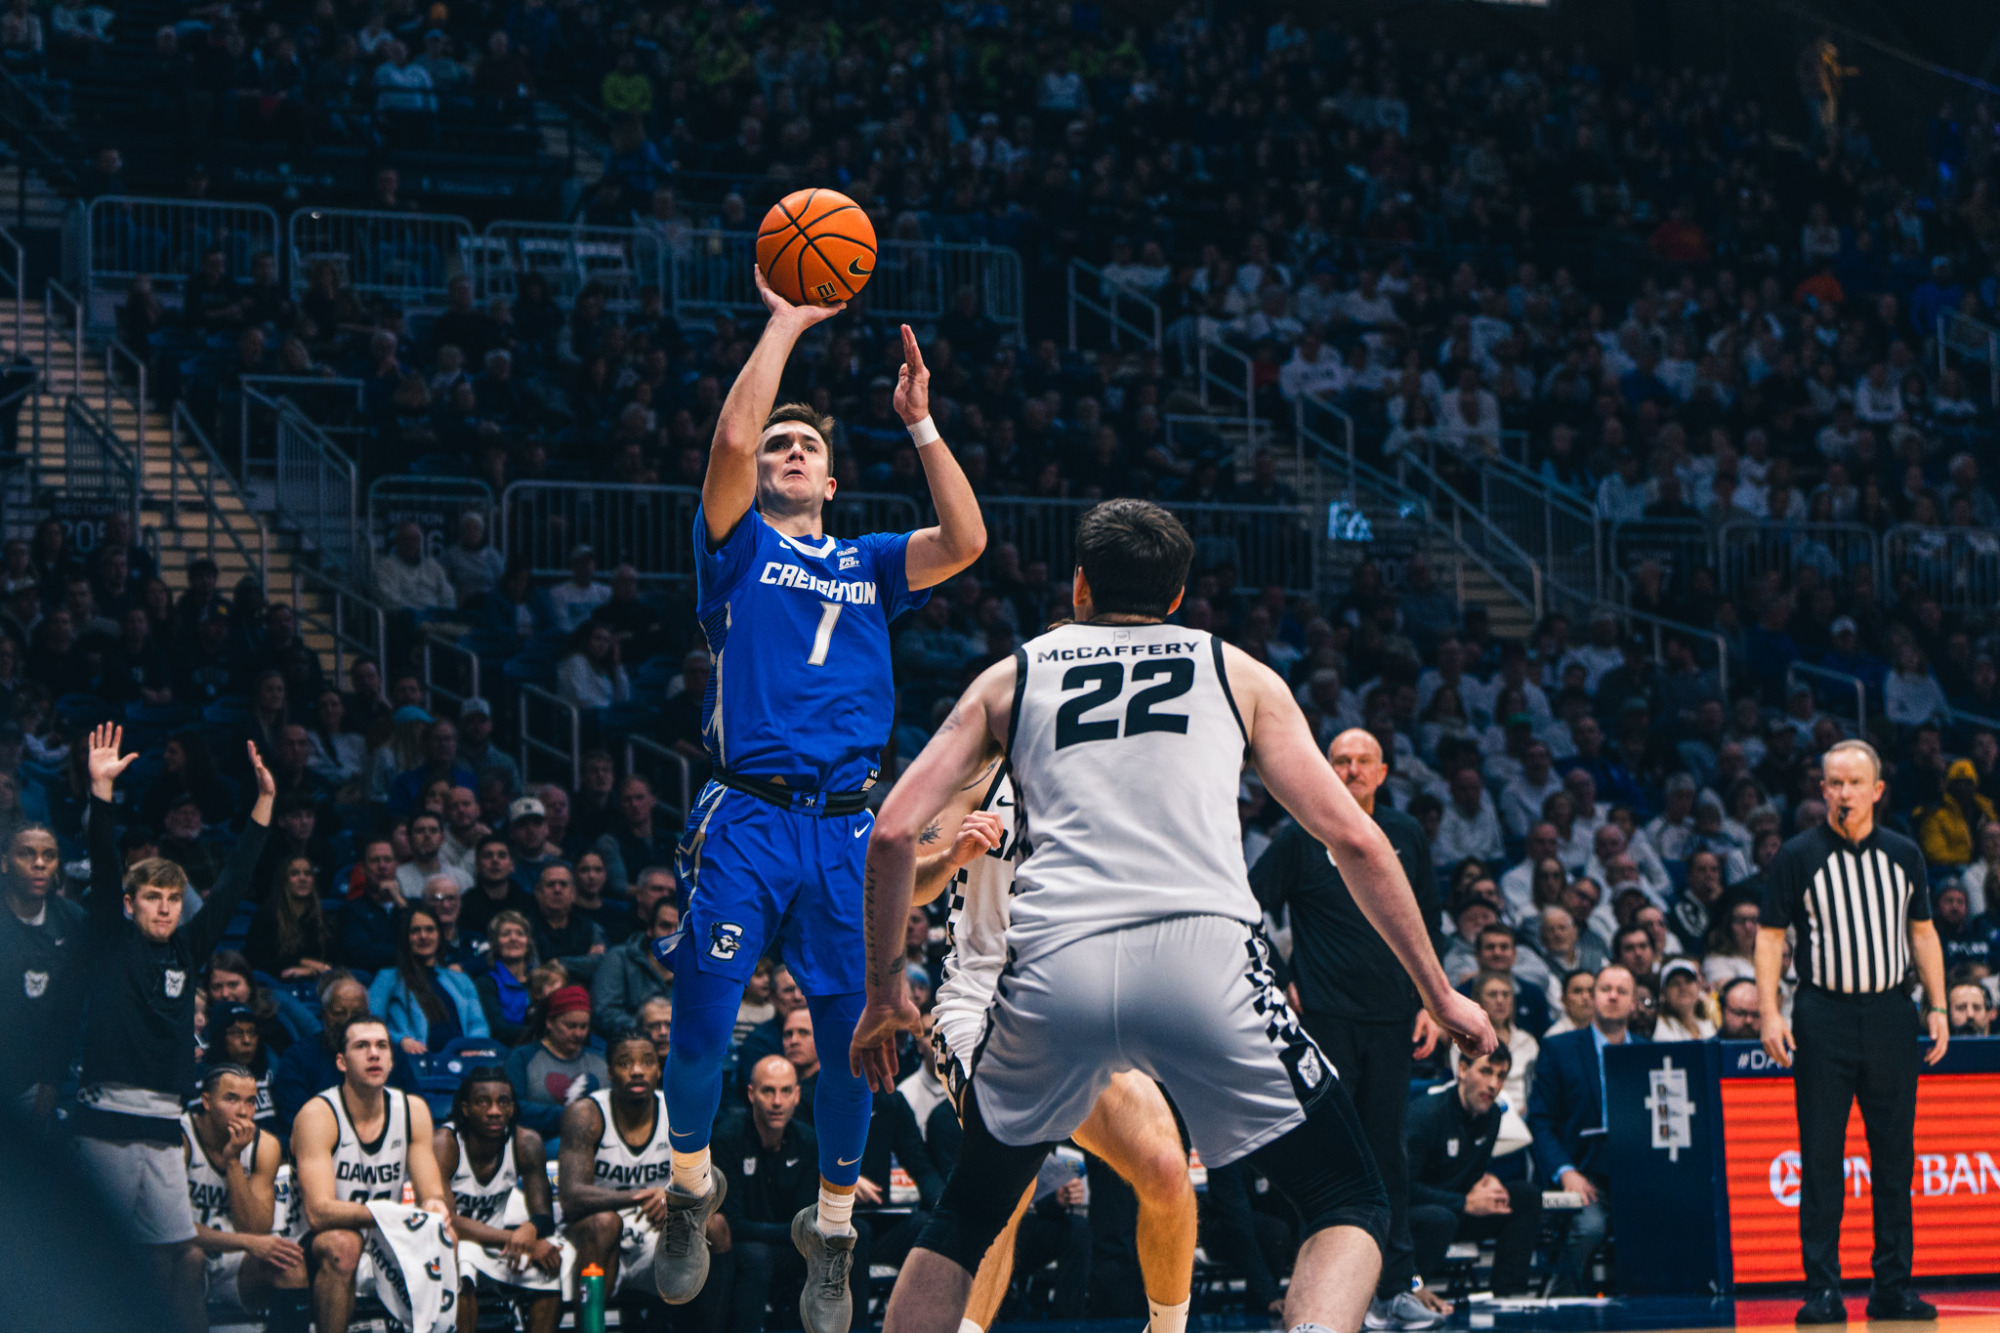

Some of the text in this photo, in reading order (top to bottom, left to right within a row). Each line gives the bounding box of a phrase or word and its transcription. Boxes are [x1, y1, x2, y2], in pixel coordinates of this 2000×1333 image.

[807, 601, 843, 667] 1
[1055, 657, 1195, 751] 22
[336, 1161, 401, 1185] DAWGS
[594, 1160, 671, 1183] DAWGS
